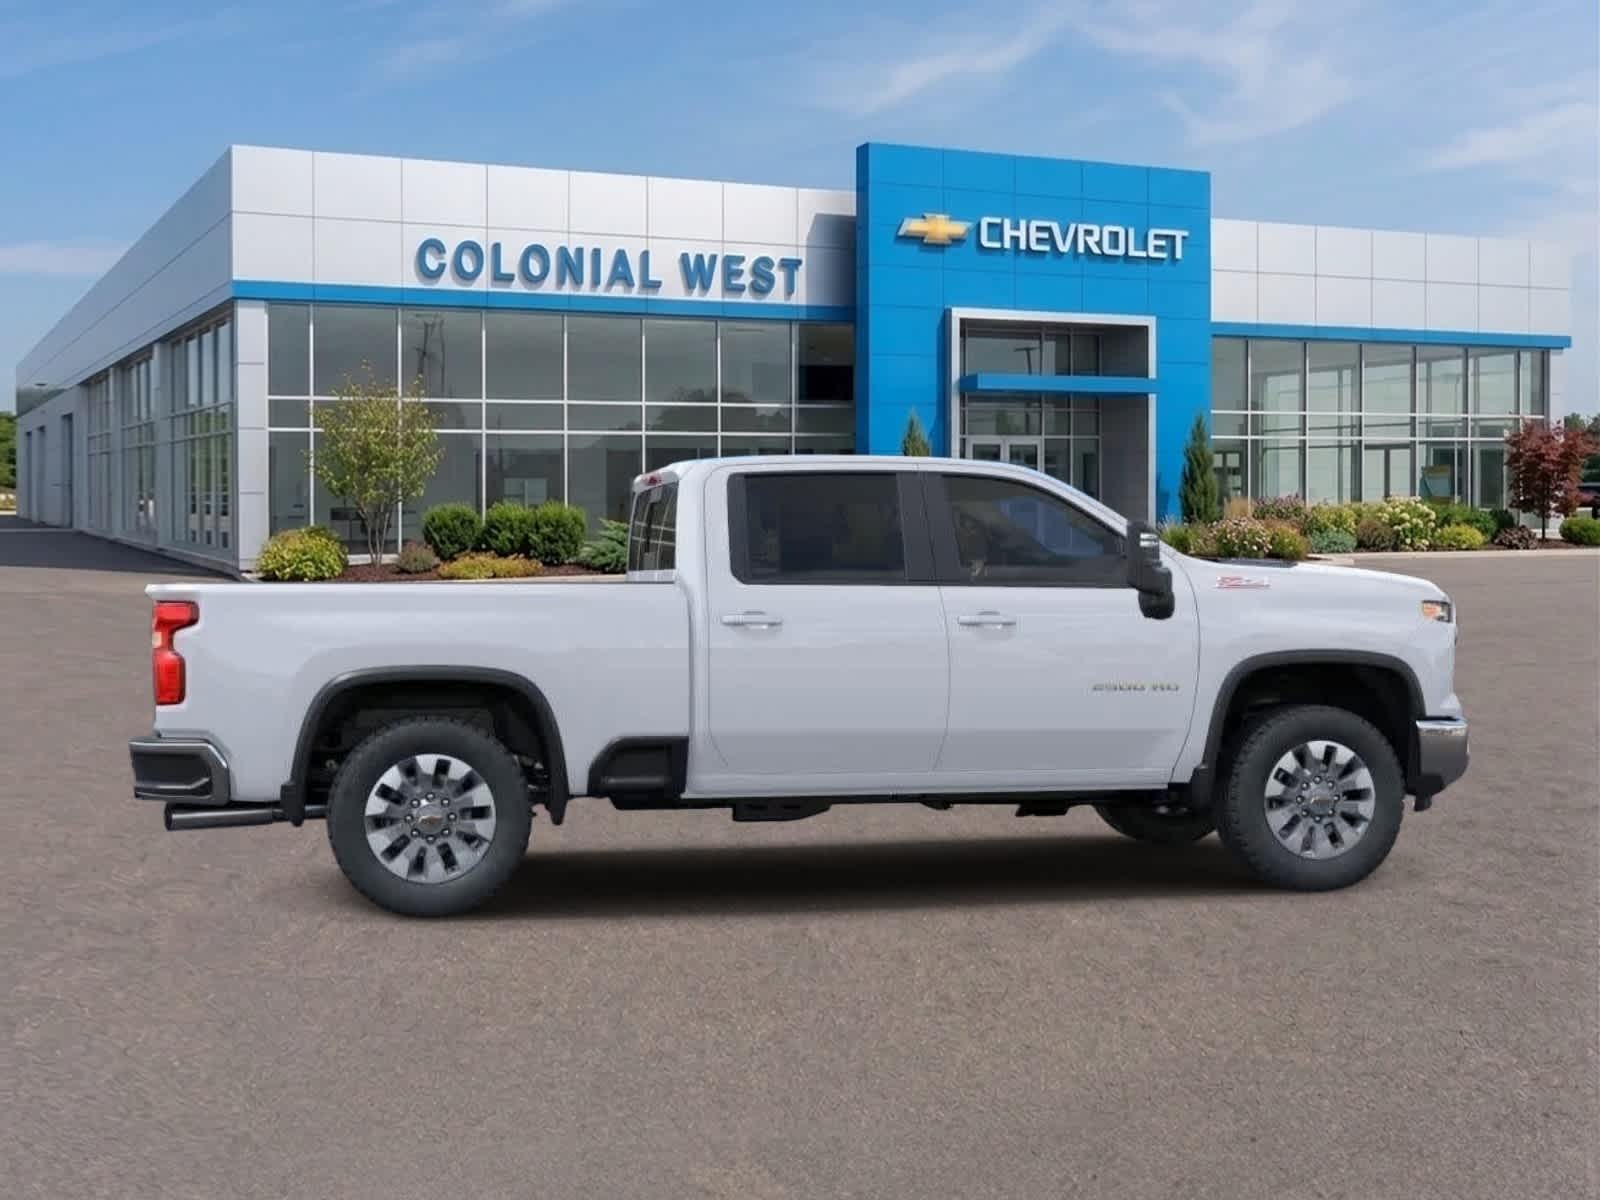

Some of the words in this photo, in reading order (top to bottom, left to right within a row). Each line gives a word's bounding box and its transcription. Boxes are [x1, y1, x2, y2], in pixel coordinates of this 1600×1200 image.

[980, 216, 1190, 262] CHEVROLET
[416, 237, 663, 290] COLONIAL
[679, 250, 803, 296] WEST
